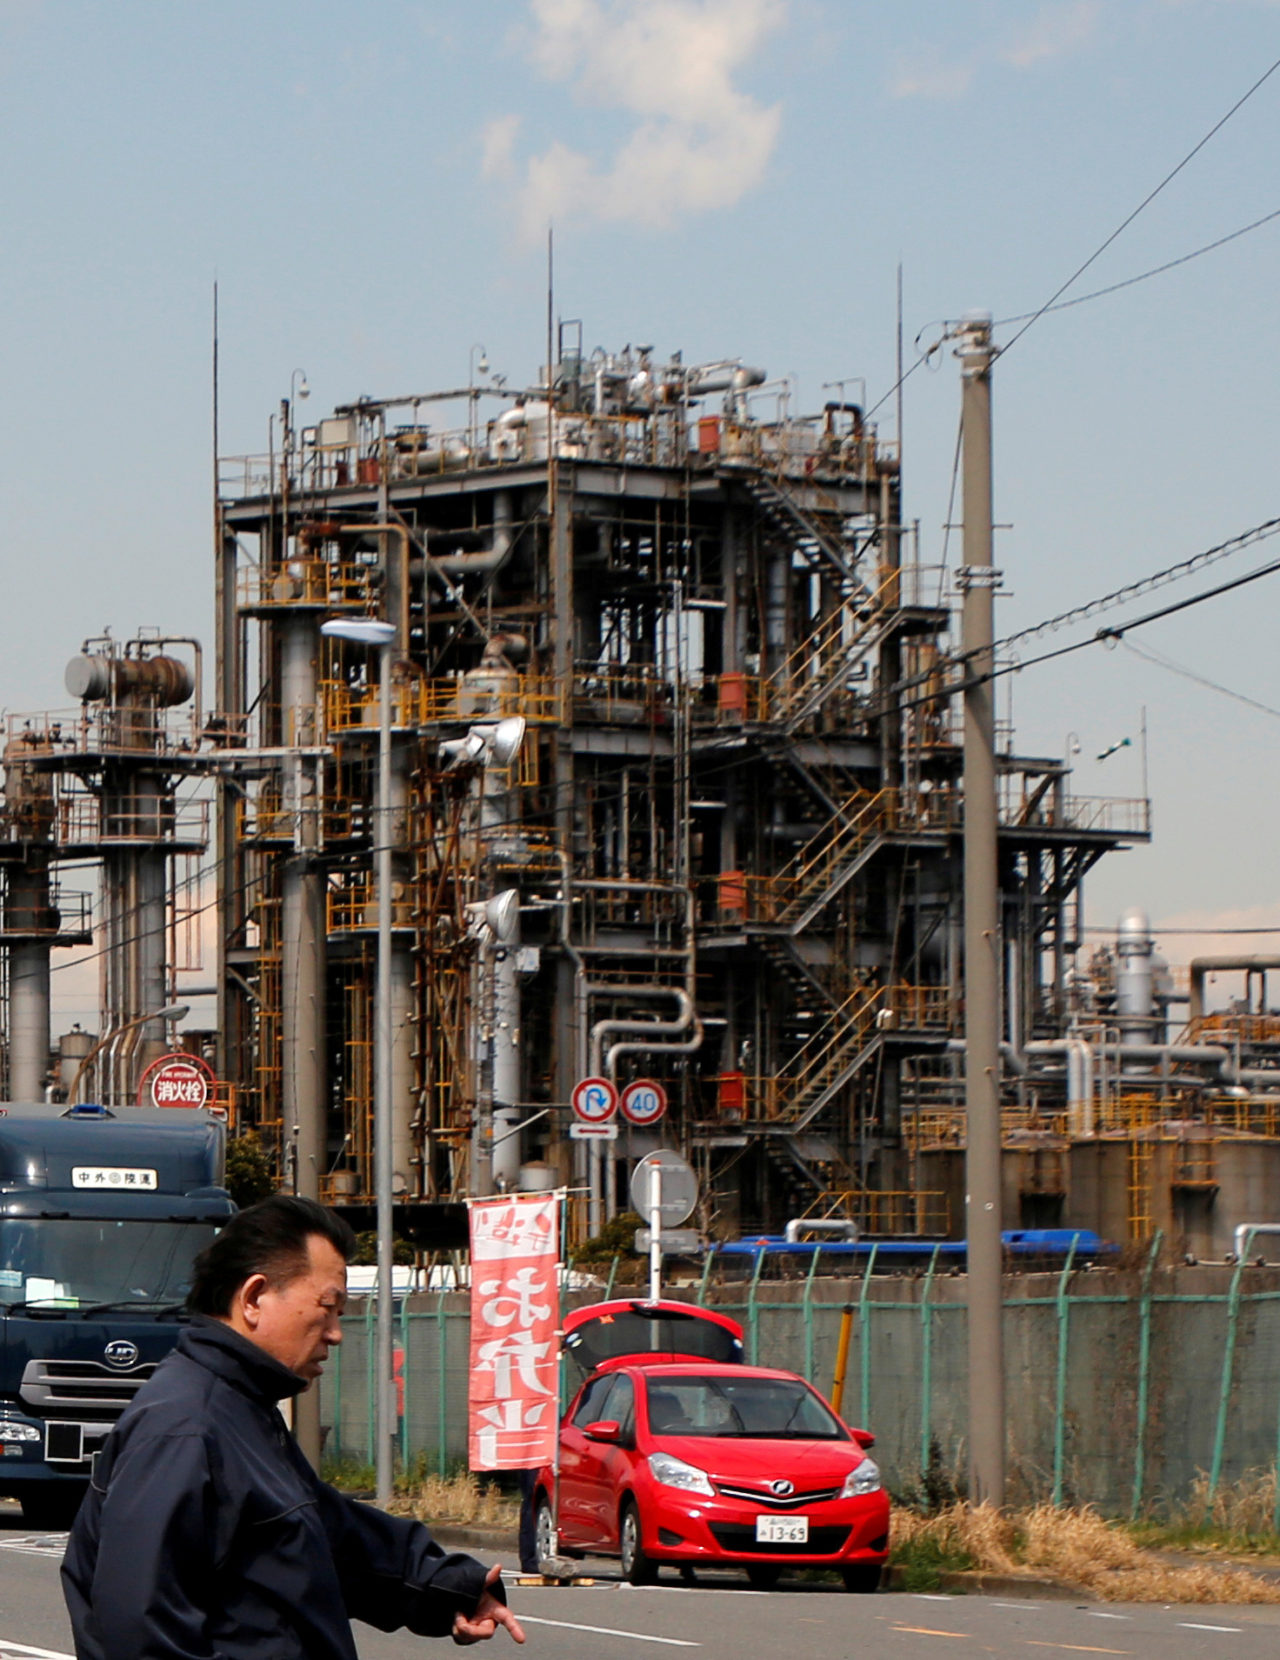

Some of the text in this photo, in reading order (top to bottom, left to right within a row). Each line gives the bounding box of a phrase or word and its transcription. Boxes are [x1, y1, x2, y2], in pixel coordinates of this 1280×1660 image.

[158, 1081, 202, 1102] 消火栓
[632, 1093, 656, 1111] 40
[770, 1527, 805, 1541] 13-69
